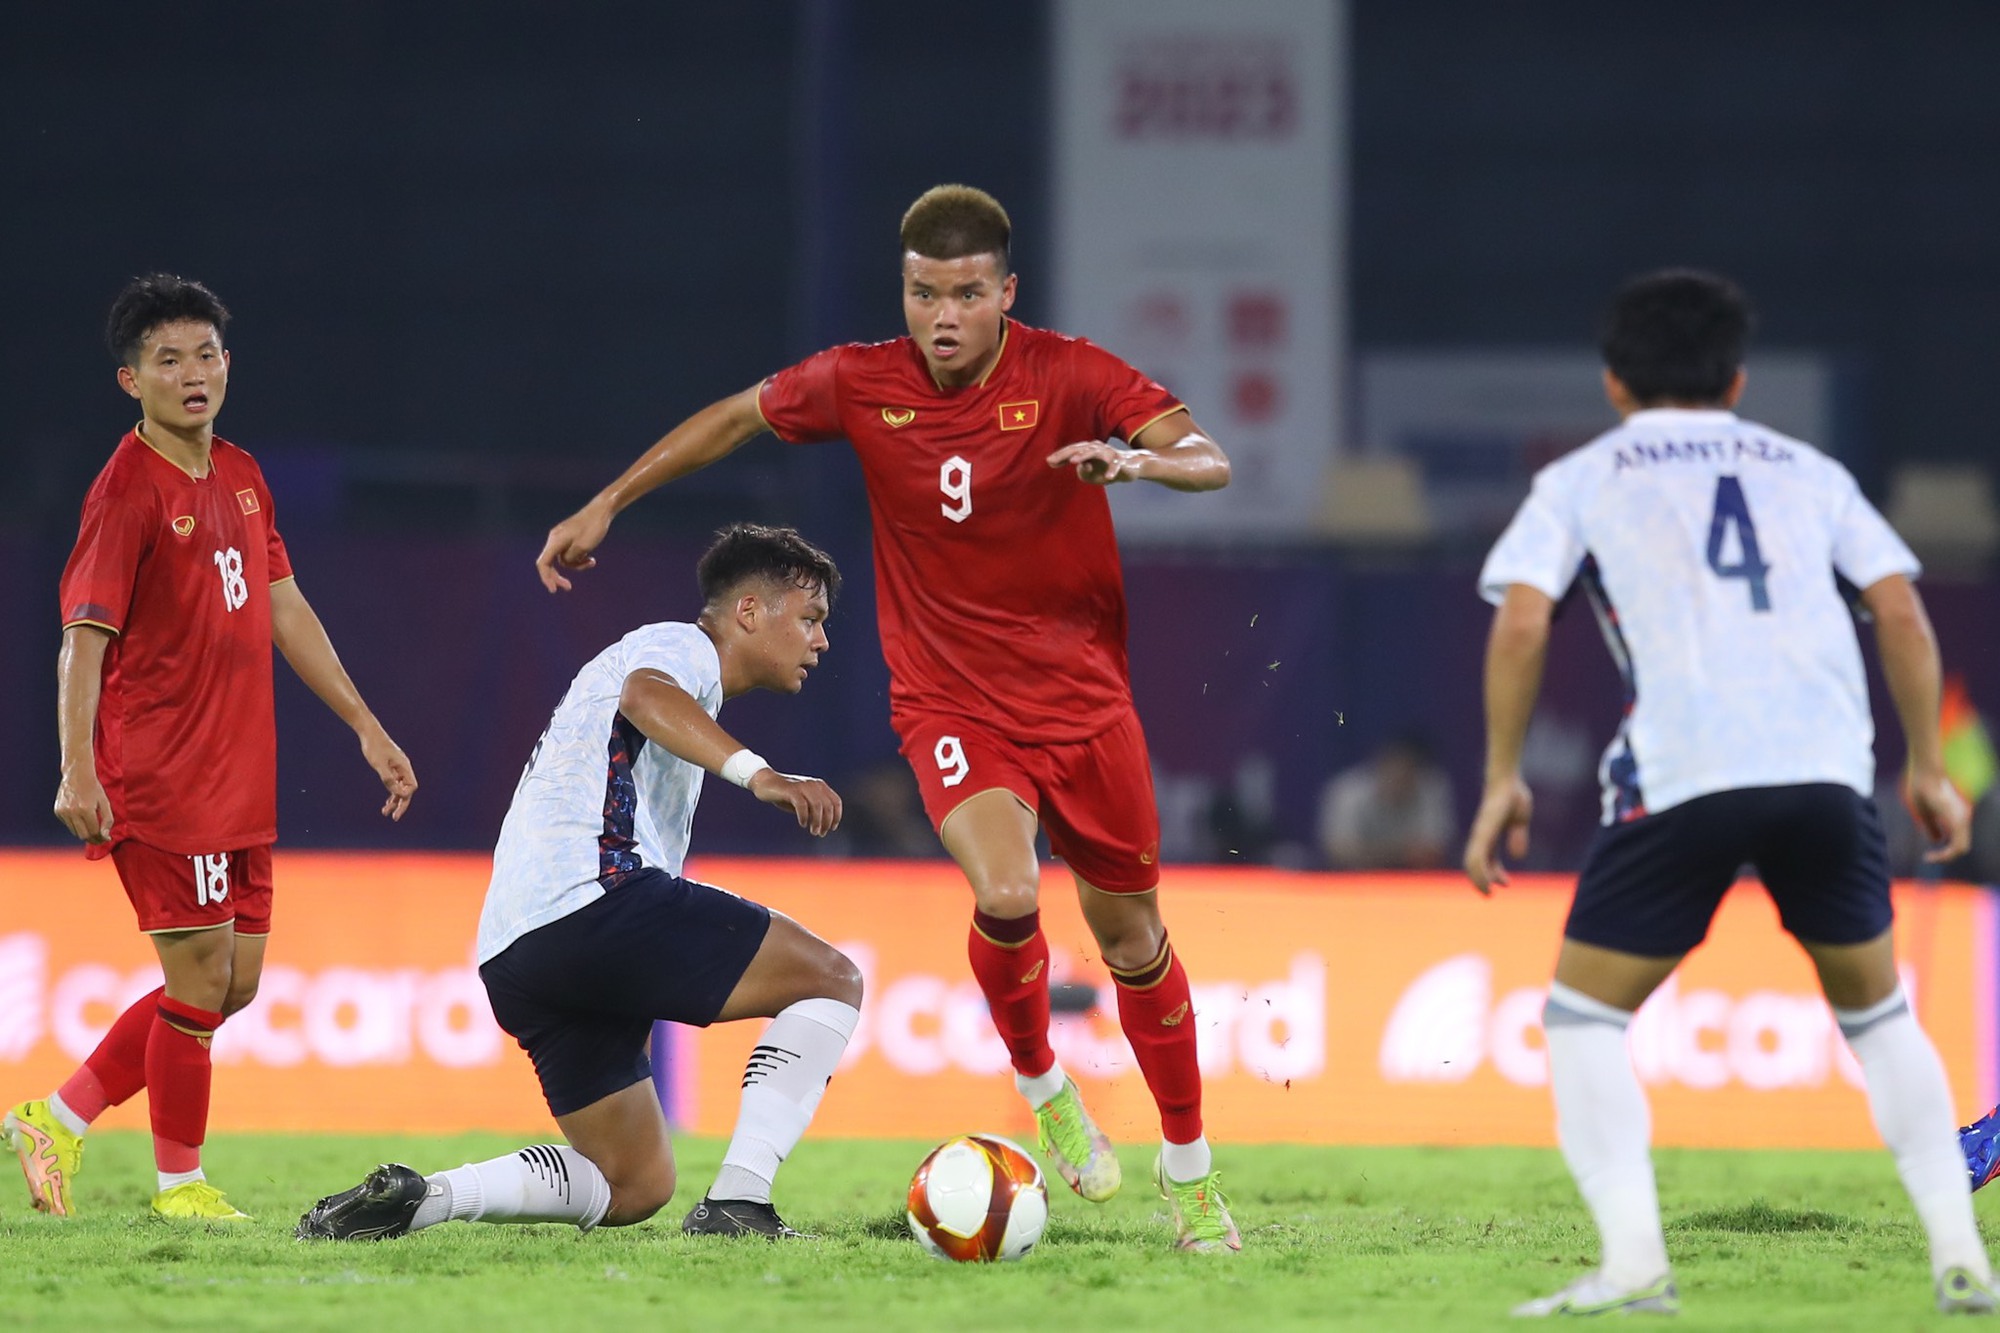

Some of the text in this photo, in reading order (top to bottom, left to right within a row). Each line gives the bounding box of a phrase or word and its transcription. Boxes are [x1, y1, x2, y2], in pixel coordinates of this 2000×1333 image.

[940, 455, 973, 523] 9
[1706, 475, 1771, 612] 4
[213, 546, 249, 613] 18
[933, 735, 970, 788] 9
[187, 852, 229, 906] 18
